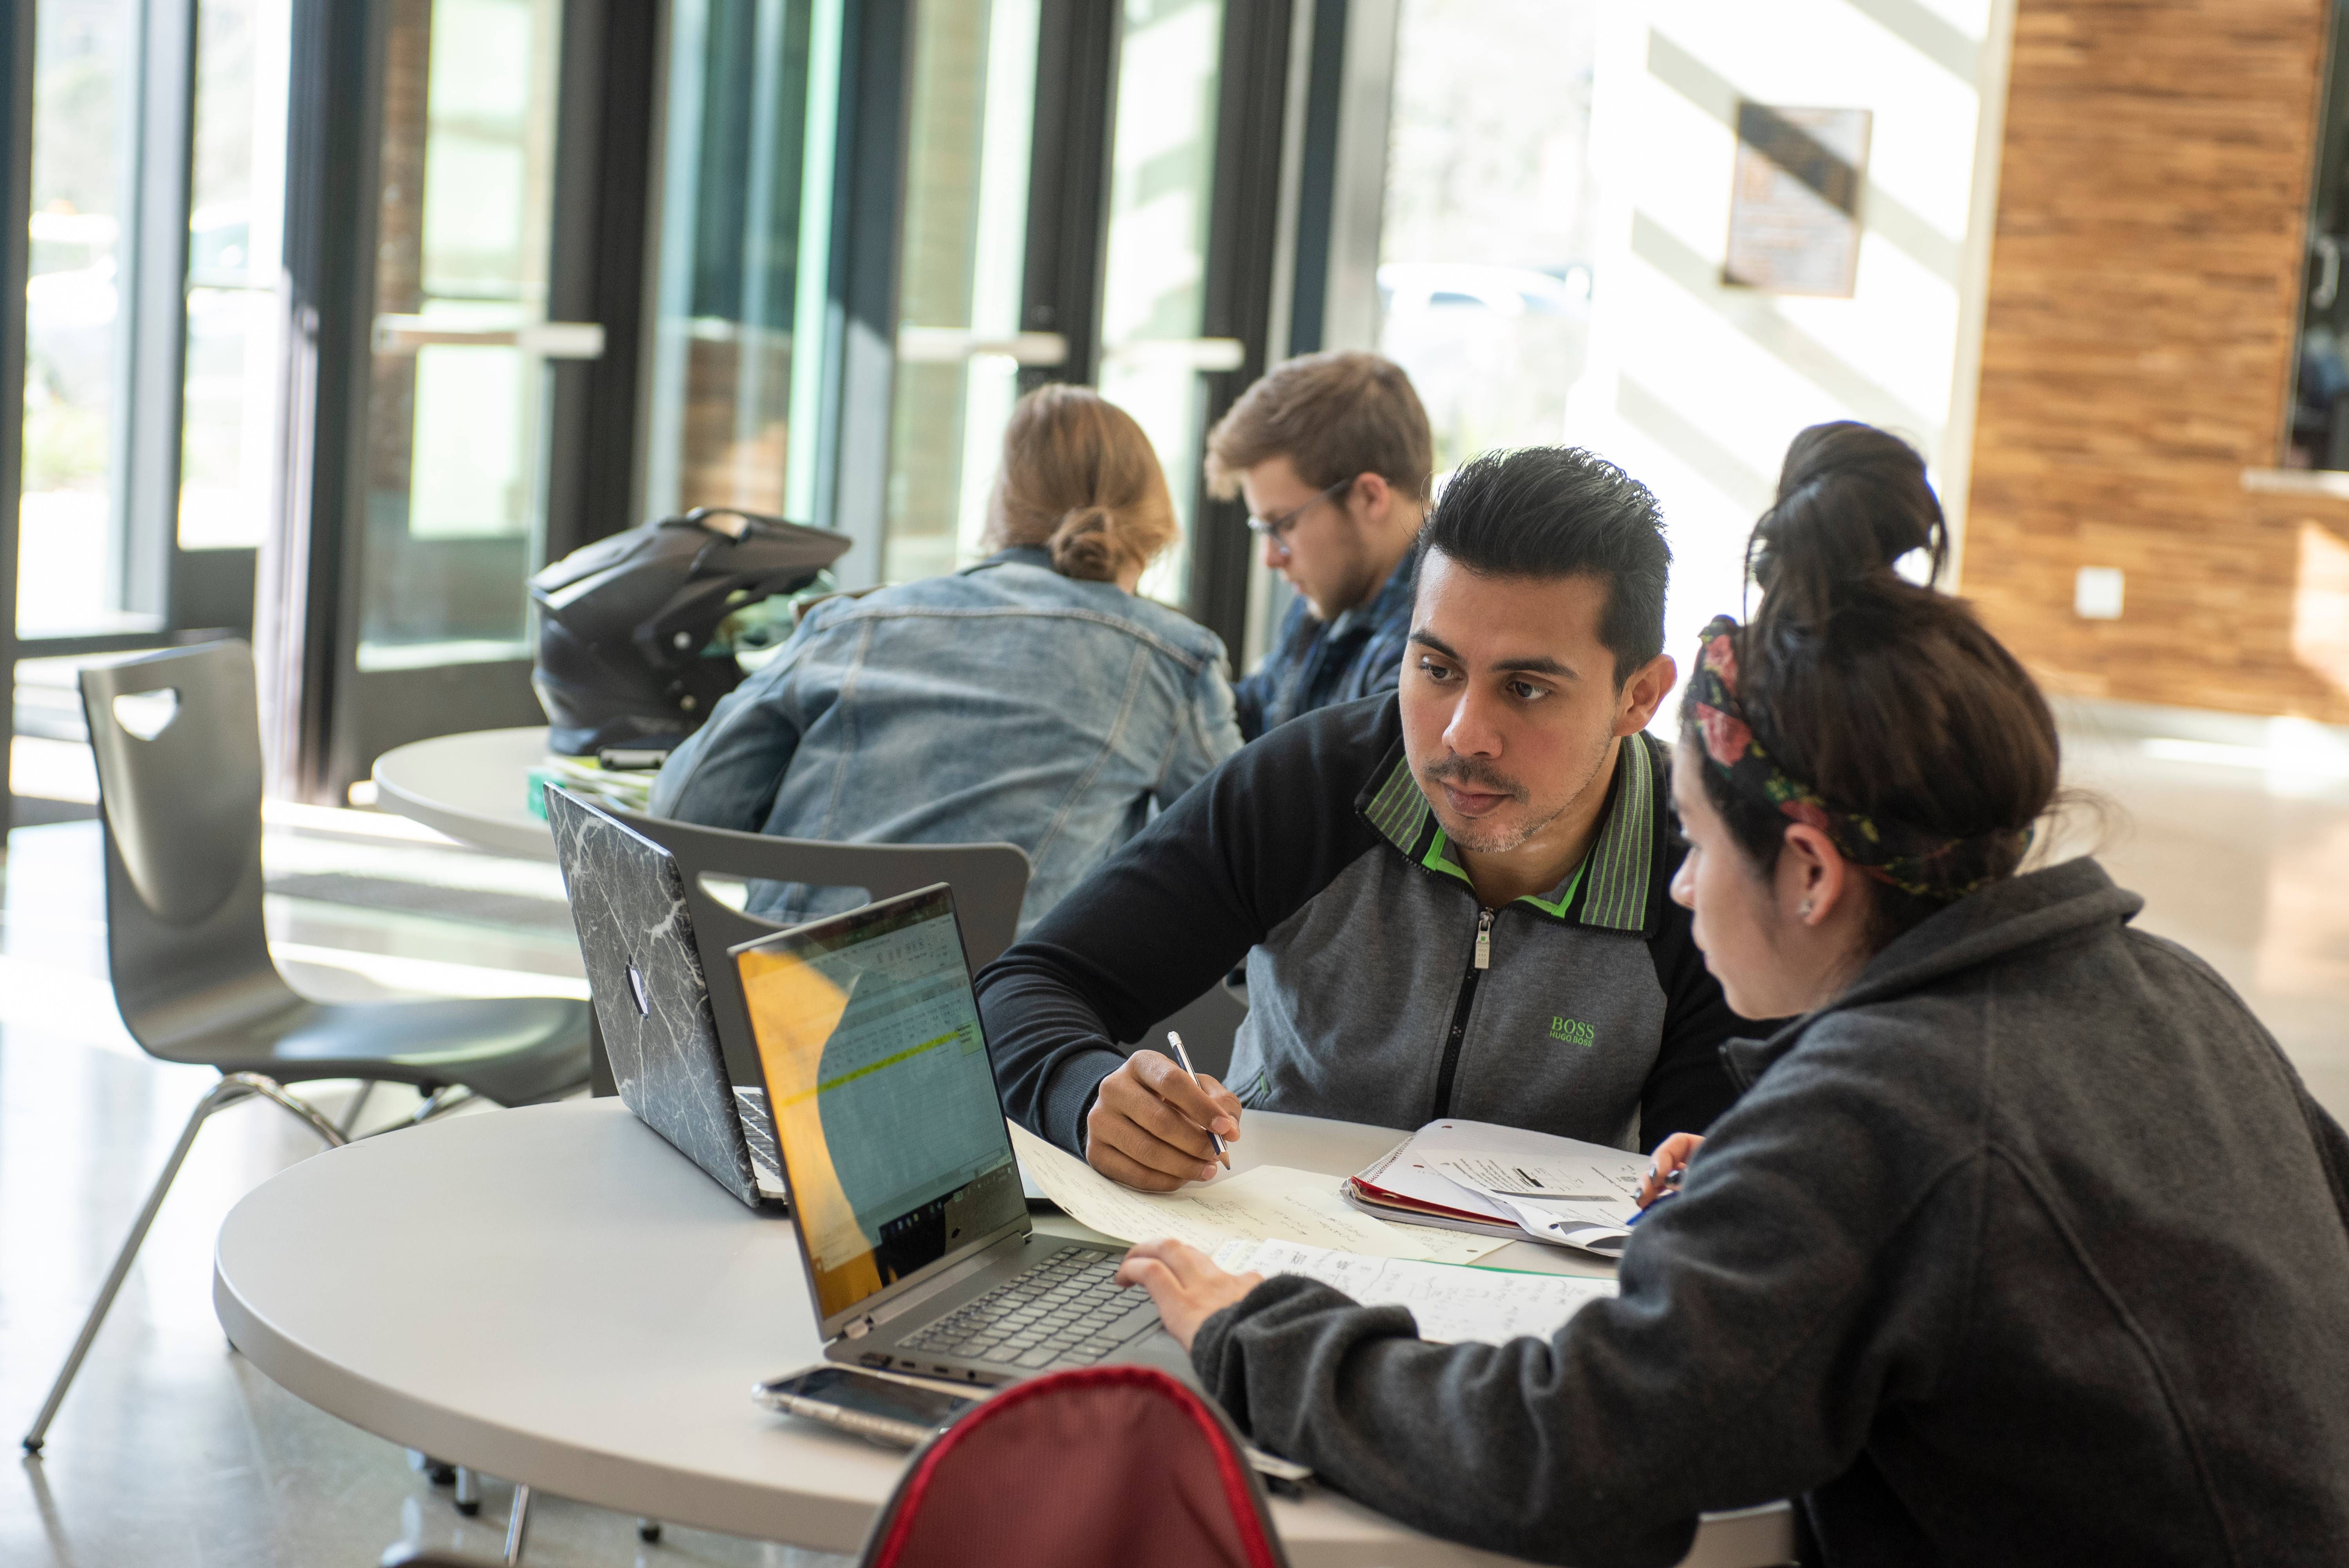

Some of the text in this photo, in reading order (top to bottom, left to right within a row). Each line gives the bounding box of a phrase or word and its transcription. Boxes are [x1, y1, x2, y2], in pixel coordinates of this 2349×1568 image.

[1552, 1016, 1594, 1039] BOSS
[1550, 1030, 1592, 1047] HUGO BOSS
